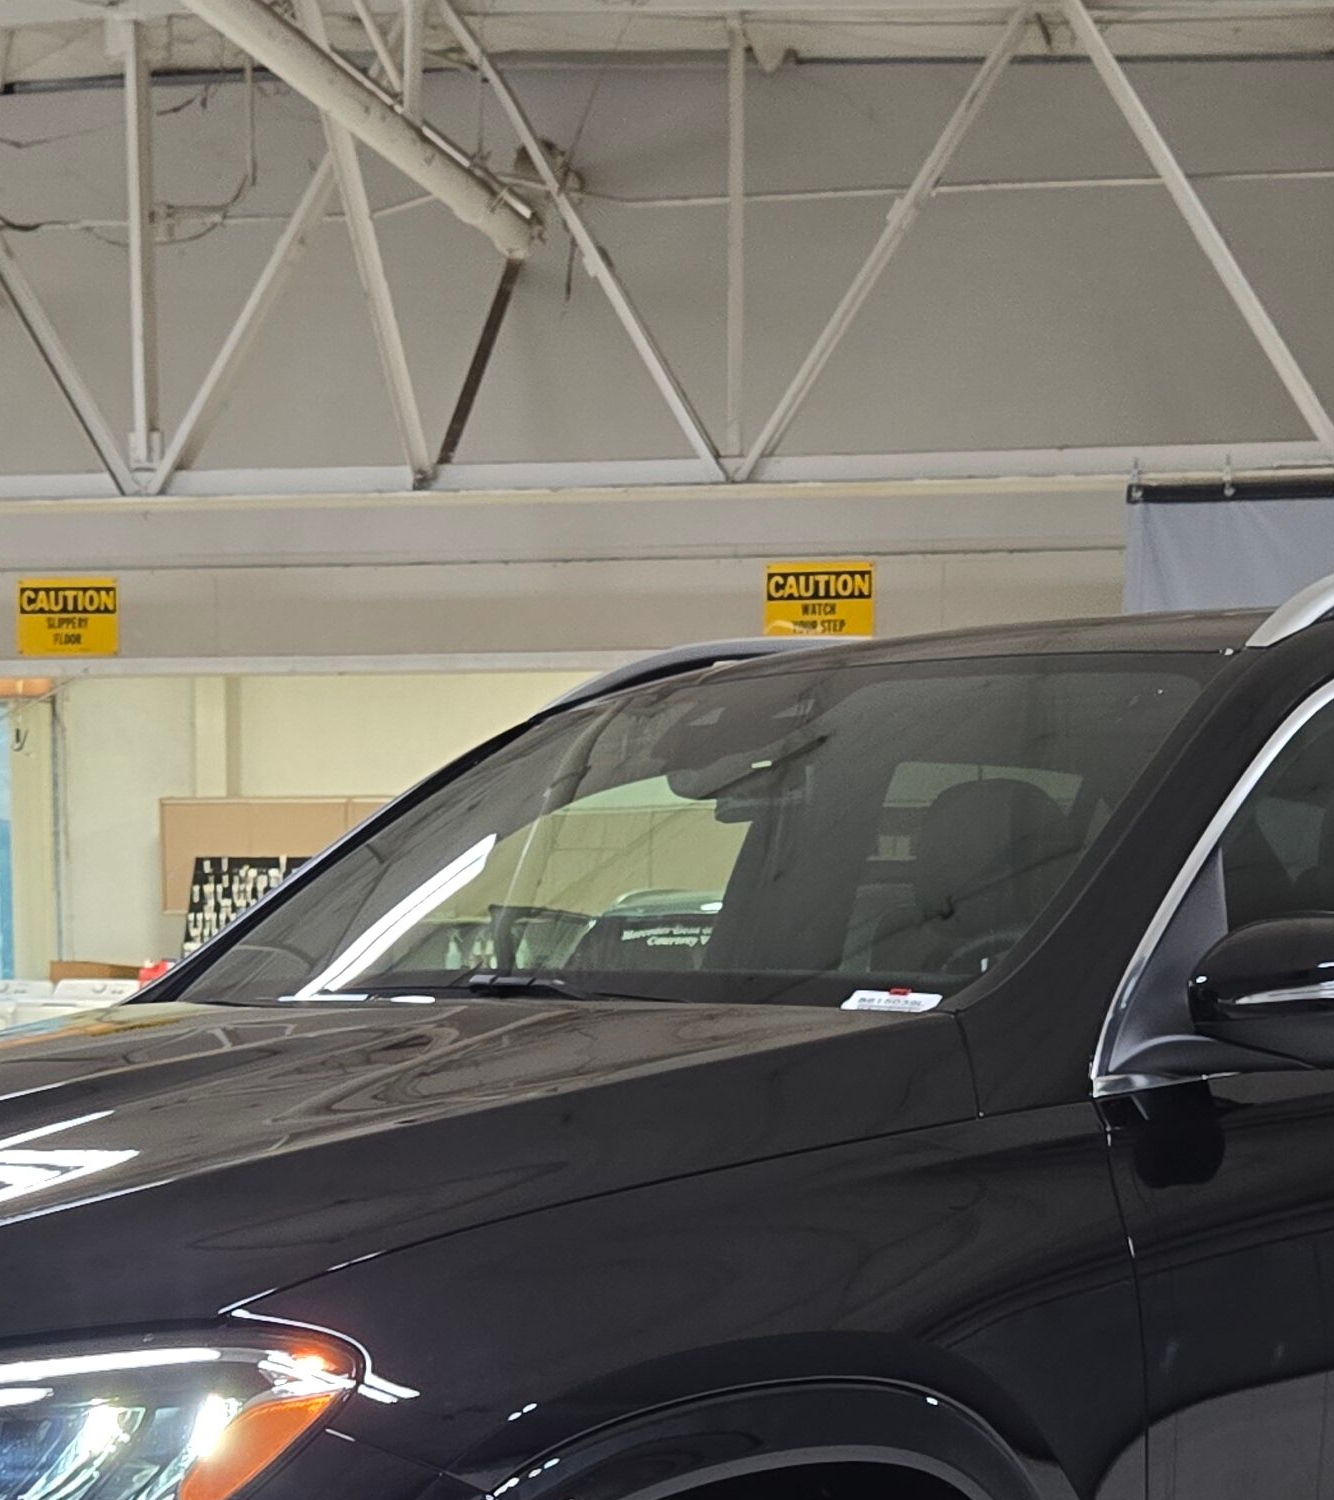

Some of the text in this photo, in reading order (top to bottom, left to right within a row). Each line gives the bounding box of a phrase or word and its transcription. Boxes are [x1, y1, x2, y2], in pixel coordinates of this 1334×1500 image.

[768, 574, 870, 598] CAUTION
[21, 589, 115, 612] CAUTION
[801, 603, 836, 616] WATCH
[821, 619, 846, 633] STEP
